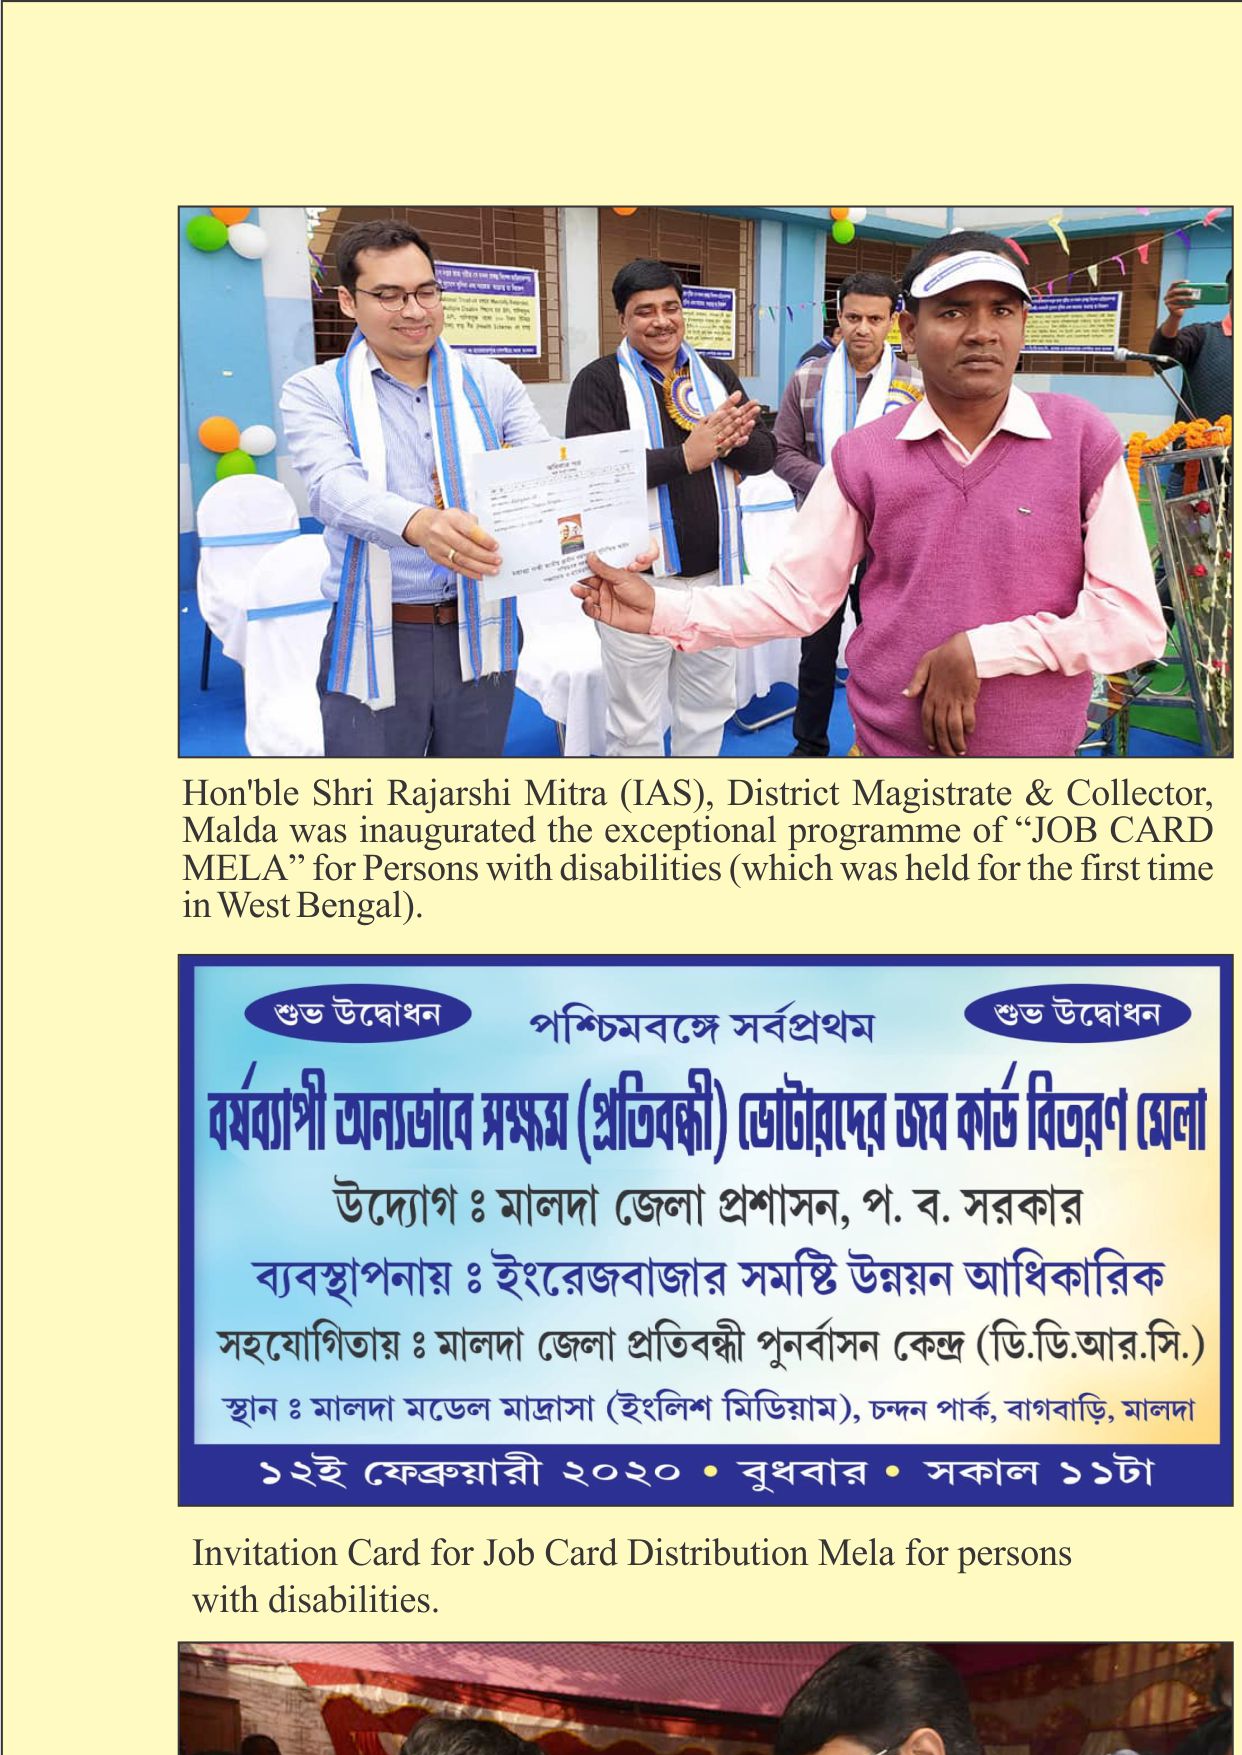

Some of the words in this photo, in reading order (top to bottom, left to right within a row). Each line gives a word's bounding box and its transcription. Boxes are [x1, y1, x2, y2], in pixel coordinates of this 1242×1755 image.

[182, 778, 299, 807] Hon'ble
[313, 778, 374, 807] Shri
[386, 777, 511, 814] Rajarshi
[524, 778, 608, 806] Mitra
[620, 778, 714, 814] (IAS),
[727, 778, 840, 807] District
[852, 778, 1012, 814] Magistrate
[1025, 778, 1054, 807] &
[1067, 778, 1213, 812] Collector,
[274, 1001, 324, 1027] শুভ
[332, 995, 442, 1028] উদ্বোধন
[530, 1002, 720, 1044] পশ্চিমবঙ্গে
[729, 1001, 876, 1044] সর্বপ্রথম
[994, 1001, 1045, 1027] শুভ
[1051, 995, 1162, 1028] উদ্বোধন
[208, 1061, 327, 1150] বর্ষব্যাপী
[334, 1088, 474, 1150] অন্যভাবে
[481, 1093, 568, 1151] সক্ষম
[578, 1068, 727, 1164] (প্রতিবন্ধী)
[739, 1072, 887, 1157] ভোটারদের
[895, 1093, 948, 1150] জব
[956, 1061, 1019, 1150] কার্ড
[1027, 1071, 1128, 1157] বিতরণ
[1138, 1088, 1207, 1150] মেলা
[332, 1175, 458, 1228] উদ্যোগ
[496, 1184, 599, 1226] মালদা
[616, 1184, 705, 1226] জেলা
[720, 1184, 849, 1229] প্রশাসন,
[863, 1184, 901, 1225] প.
[912, 1190, 949, 1225] ব.
[960, 1184, 1083, 1226] সরকার
[251, 1257, 452, 1307] ব্যবস্থাপনায়
[491, 1249, 727, 1300] ইংরেজবাজার
[738, 1248, 837, 1296] সমষ্টি
[846, 1249, 953, 1296] উন্নয়ন
[963, 1248, 1165, 1296] আধিকারিক
[216, 1318, 400, 1365] সহযোগিতায়
[434, 1327, 524, 1361] মালদা
[539, 1327, 616, 1361] জেলা
[628, 1318, 745, 1363] প্রতিবন্ধী
[757, 1318, 880, 1370] পুনর্বাসন
[895, 1332, 965, 1363] কেন্দ্র
[977, 1318, 1204, 1366] (ডি.ডি.আর.সি.)
[222, 1395, 278, 1428] স্থান
[310, 1396, 395, 1421] মালদা
[403, 1399, 491, 1421] মডেল
[500, 1395, 595, 1422] মাদ্রাসা
[607, 1389, 712, 1424] (ইংলিশ
[722, 1389, 860, 1424] মিডিয়াম),
[869, 1401, 926, 1420] চন্দন
[937, 1393, 996, 1422] পার্ক,
[1004, 1393, 1114, 1425] বাগবাড়ি,
[1122, 1399, 1195, 1421] মালদা
[261, 1452, 346, 1488] ১২ই
[365, 1451, 542, 1486] ফেব্রুয়ারী
[563, 1462, 679, 1486] ২০২০
[737, 1459, 867, 1492] বুধবার
[923, 1459, 1039, 1485] সকাল
[191, 1584, 259, 1614] with
[268, 1584, 439, 1614] disabilities.
